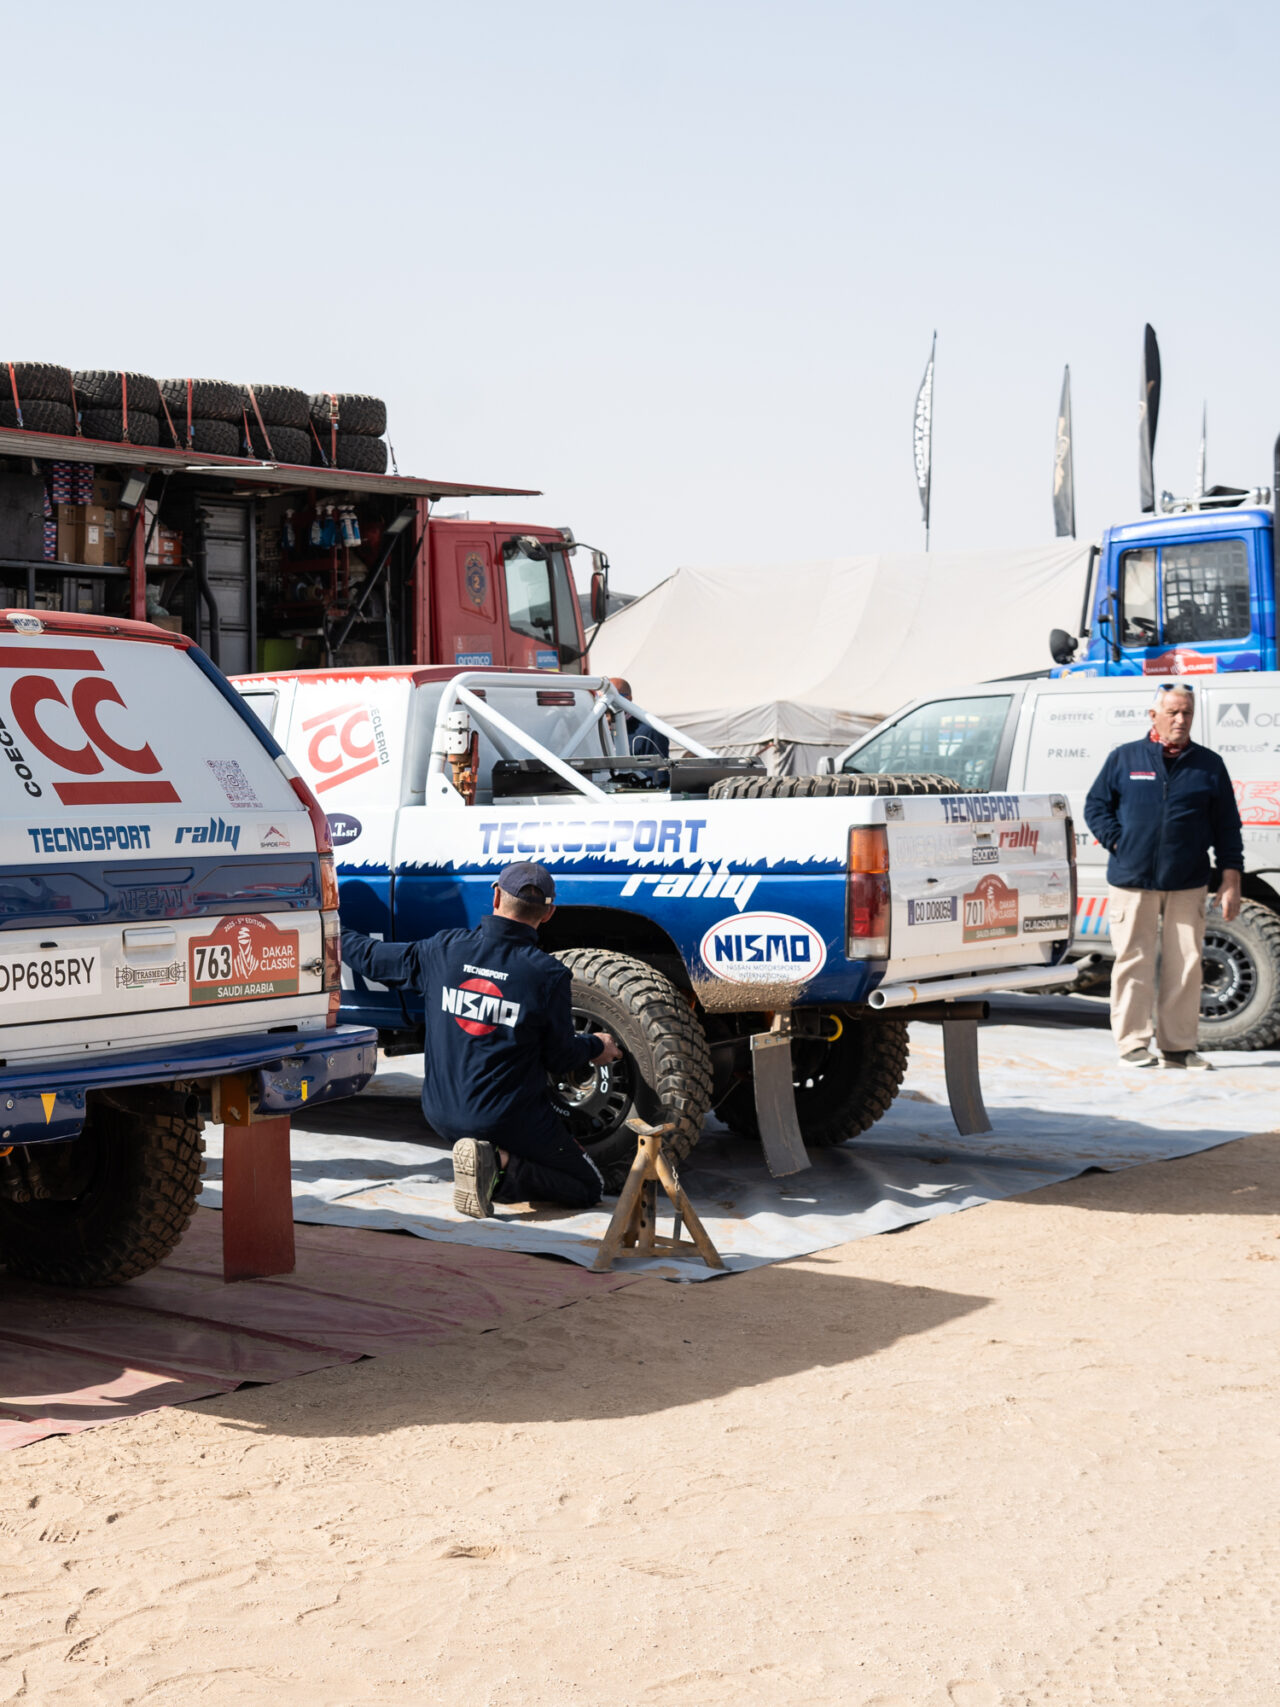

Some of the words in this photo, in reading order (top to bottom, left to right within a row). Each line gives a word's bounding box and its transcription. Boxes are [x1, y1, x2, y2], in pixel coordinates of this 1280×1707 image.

[458, 655, 490, 666] aramco
[940, 795, 1020, 824] TECNOSPORT
[27, 825, 151, 853] TECNOSPORT
[175, 816, 241, 851] rally
[998, 821, 1039, 856] rally
[620, 861, 762, 912] rally
[966, 901, 983, 926] 701
[262, 945, 293, 958] DAKAR
[714, 934, 811, 962] NISMO
[195, 947, 232, 981] 763
[260, 957, 296, 971] CLASSIC
[463, 964, 509, 981] TECNOSPORT
[217, 985, 243, 998] SAUDI
[243, 983, 274, 996] ARABIA
[441, 986, 521, 1028] NISMO
